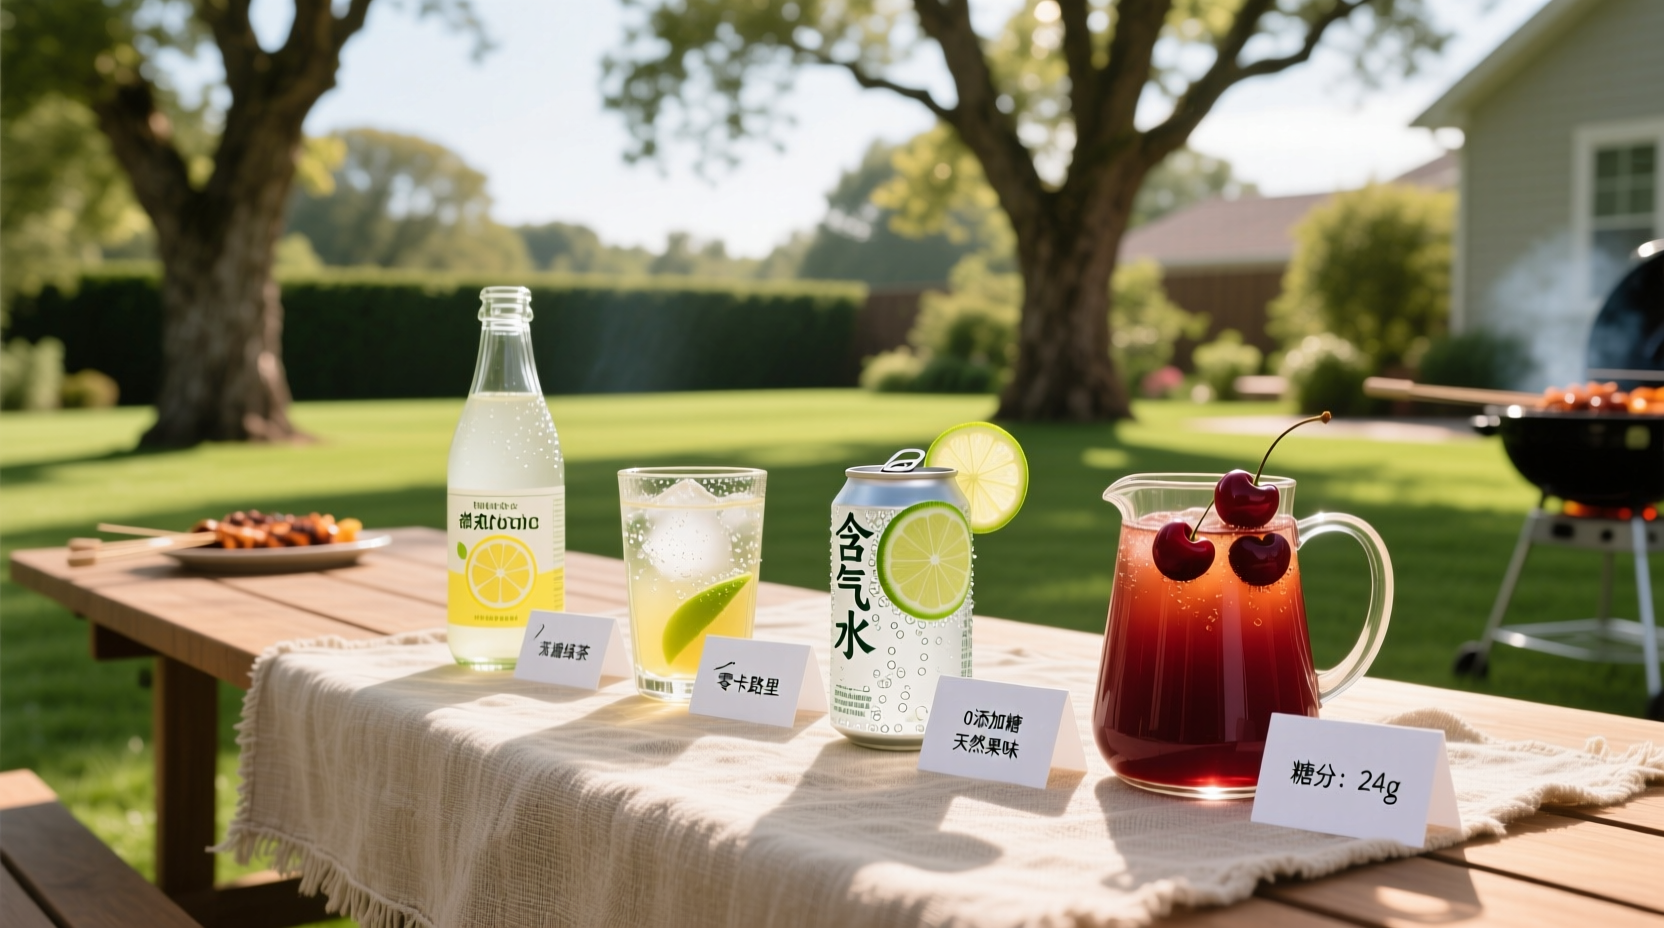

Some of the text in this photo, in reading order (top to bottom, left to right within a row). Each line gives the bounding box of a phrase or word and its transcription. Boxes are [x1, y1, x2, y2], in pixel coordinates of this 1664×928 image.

[834, 512, 876, 660] 含气水
[964, 709, 1023, 733] 0添加糖
[953, 733, 1019, 759] 天然果味
